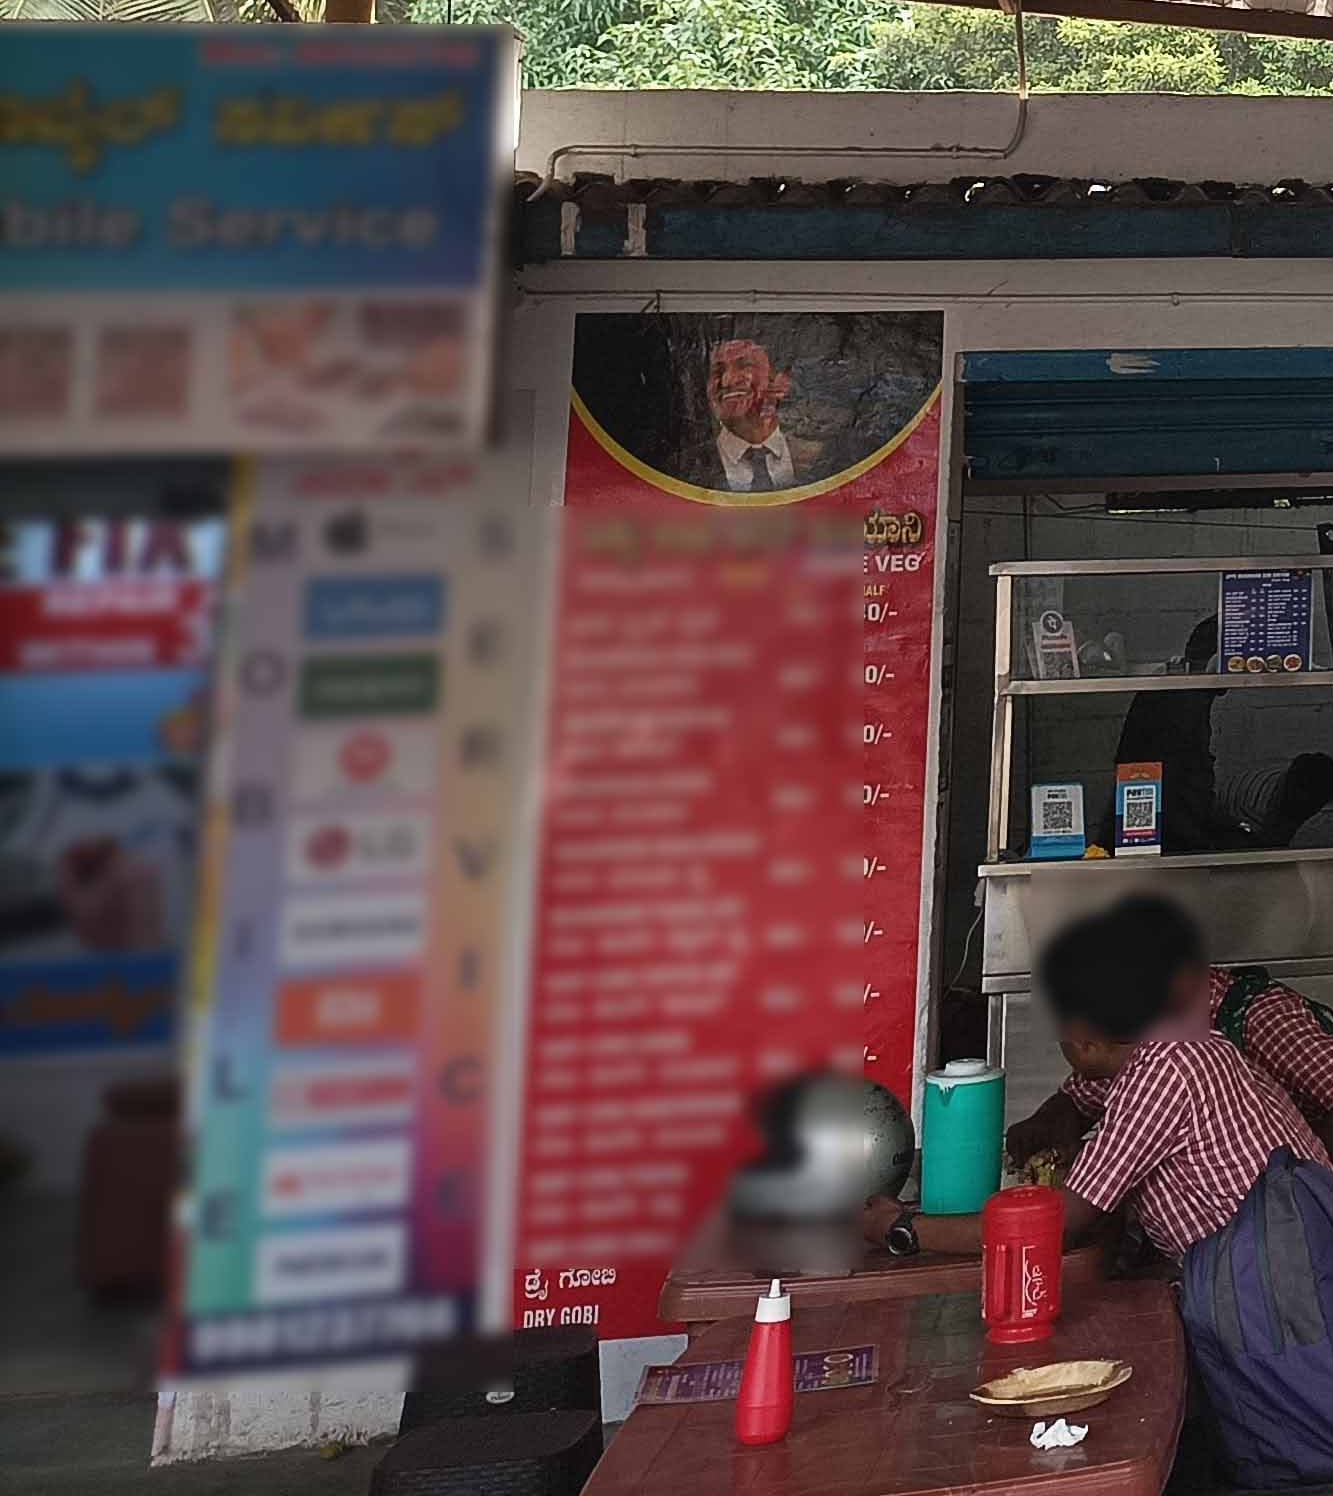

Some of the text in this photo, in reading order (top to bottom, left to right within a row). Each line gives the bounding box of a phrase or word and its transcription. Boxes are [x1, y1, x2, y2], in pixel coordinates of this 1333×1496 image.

[875, 554, 921, 573] VEG
[523, 1304, 599, 1329] DRY GOBI
